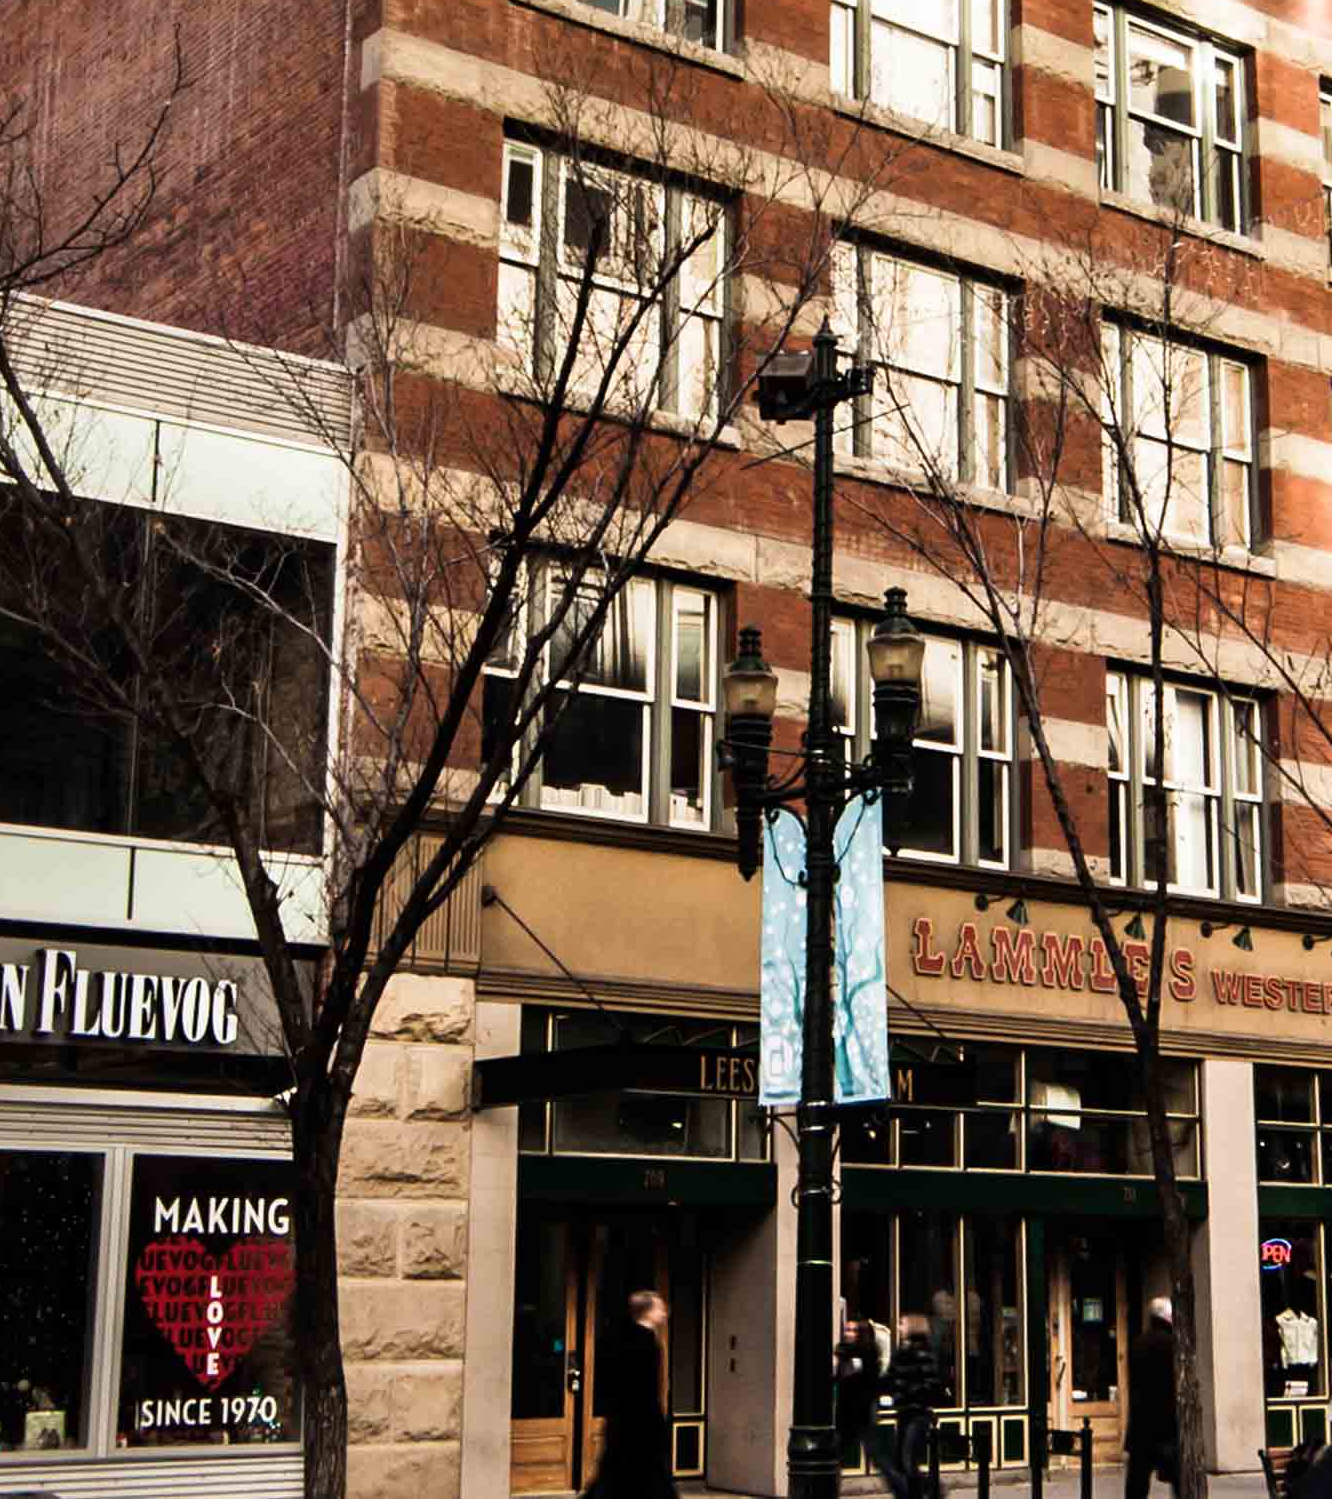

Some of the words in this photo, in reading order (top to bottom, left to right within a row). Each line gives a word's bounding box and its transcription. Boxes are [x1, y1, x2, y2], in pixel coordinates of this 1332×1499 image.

[35, 948, 239, 1045] FLUEVOG
[699, 1054, 756, 1094] LEES
[153, 1196, 291, 1236] MAKING
[1261, 1244, 1291, 1263] PEN
[206, 1275, 224, 1375] LOVE
[139, 1398, 213, 1428] SINCE
[220, 1396, 278, 1424] 1970
